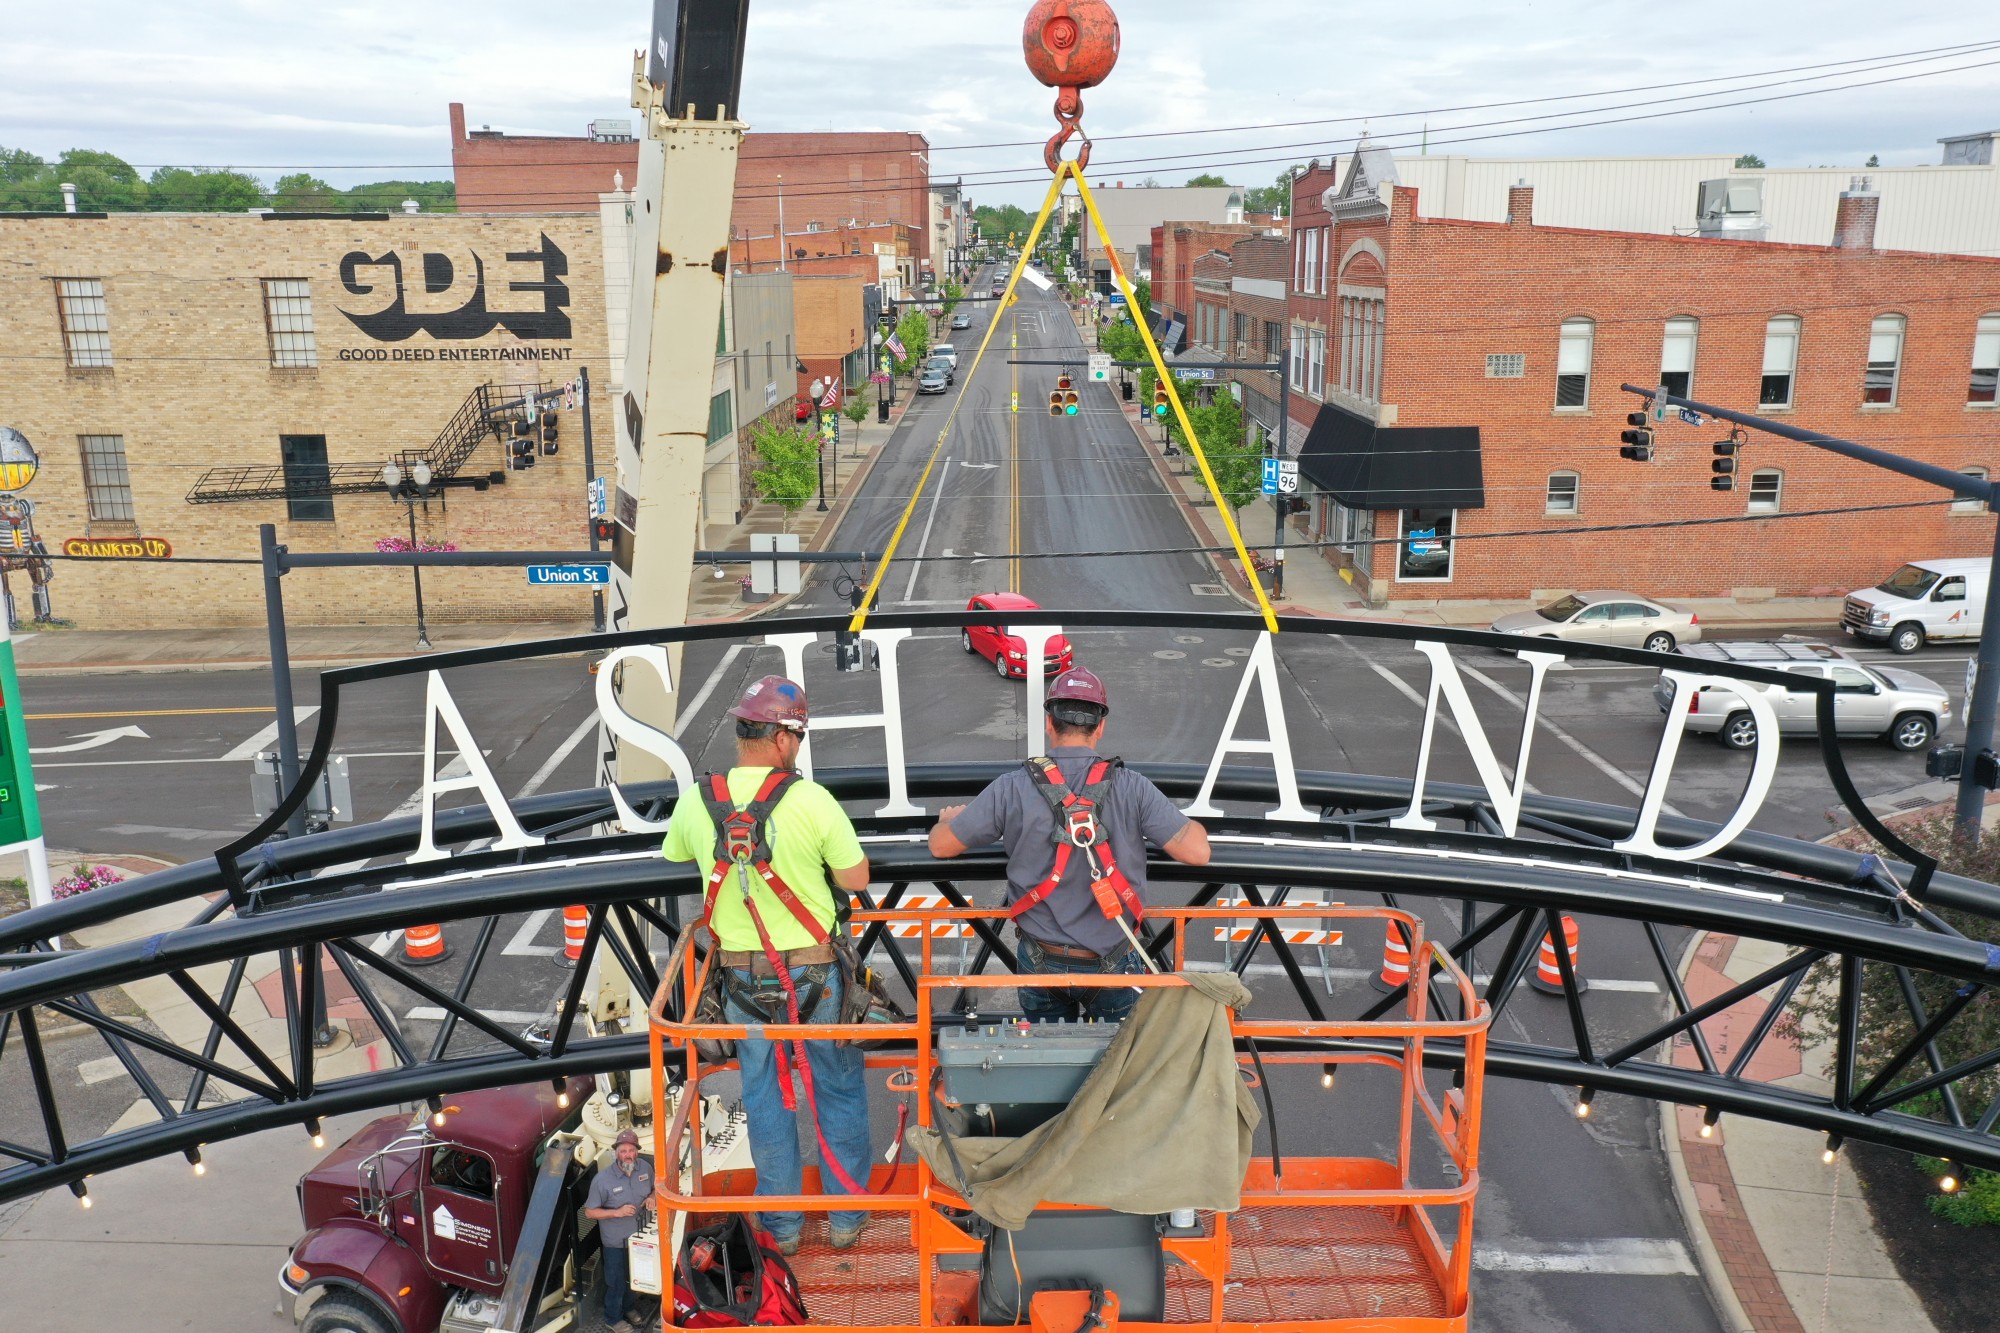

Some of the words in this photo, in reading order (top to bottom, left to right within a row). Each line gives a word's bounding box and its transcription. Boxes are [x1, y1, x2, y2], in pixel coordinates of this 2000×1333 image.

[335, 231, 572, 341] GDE
[339, 347, 388, 361] GOOD
[393, 347, 435, 361] DEED
[439, 347, 572, 361] ENTERTAINMENT
[1180, 370, 1200, 378] Union
[1201, 370, 1209, 378] St
[1281, 476, 1296, 488] 96
[589, 486, 596, 498] 96
[67, 541, 143, 557] CRANKED
[146, 540, 167, 557] UP
[537, 568, 579, 582] Union
[582, 568, 598, 582] St
[454, 1219, 491, 1234] SIMONSON
[455, 1225, 492, 1239] CONSTRUCTION
[456, 1230, 478, 1240] SERVICES
